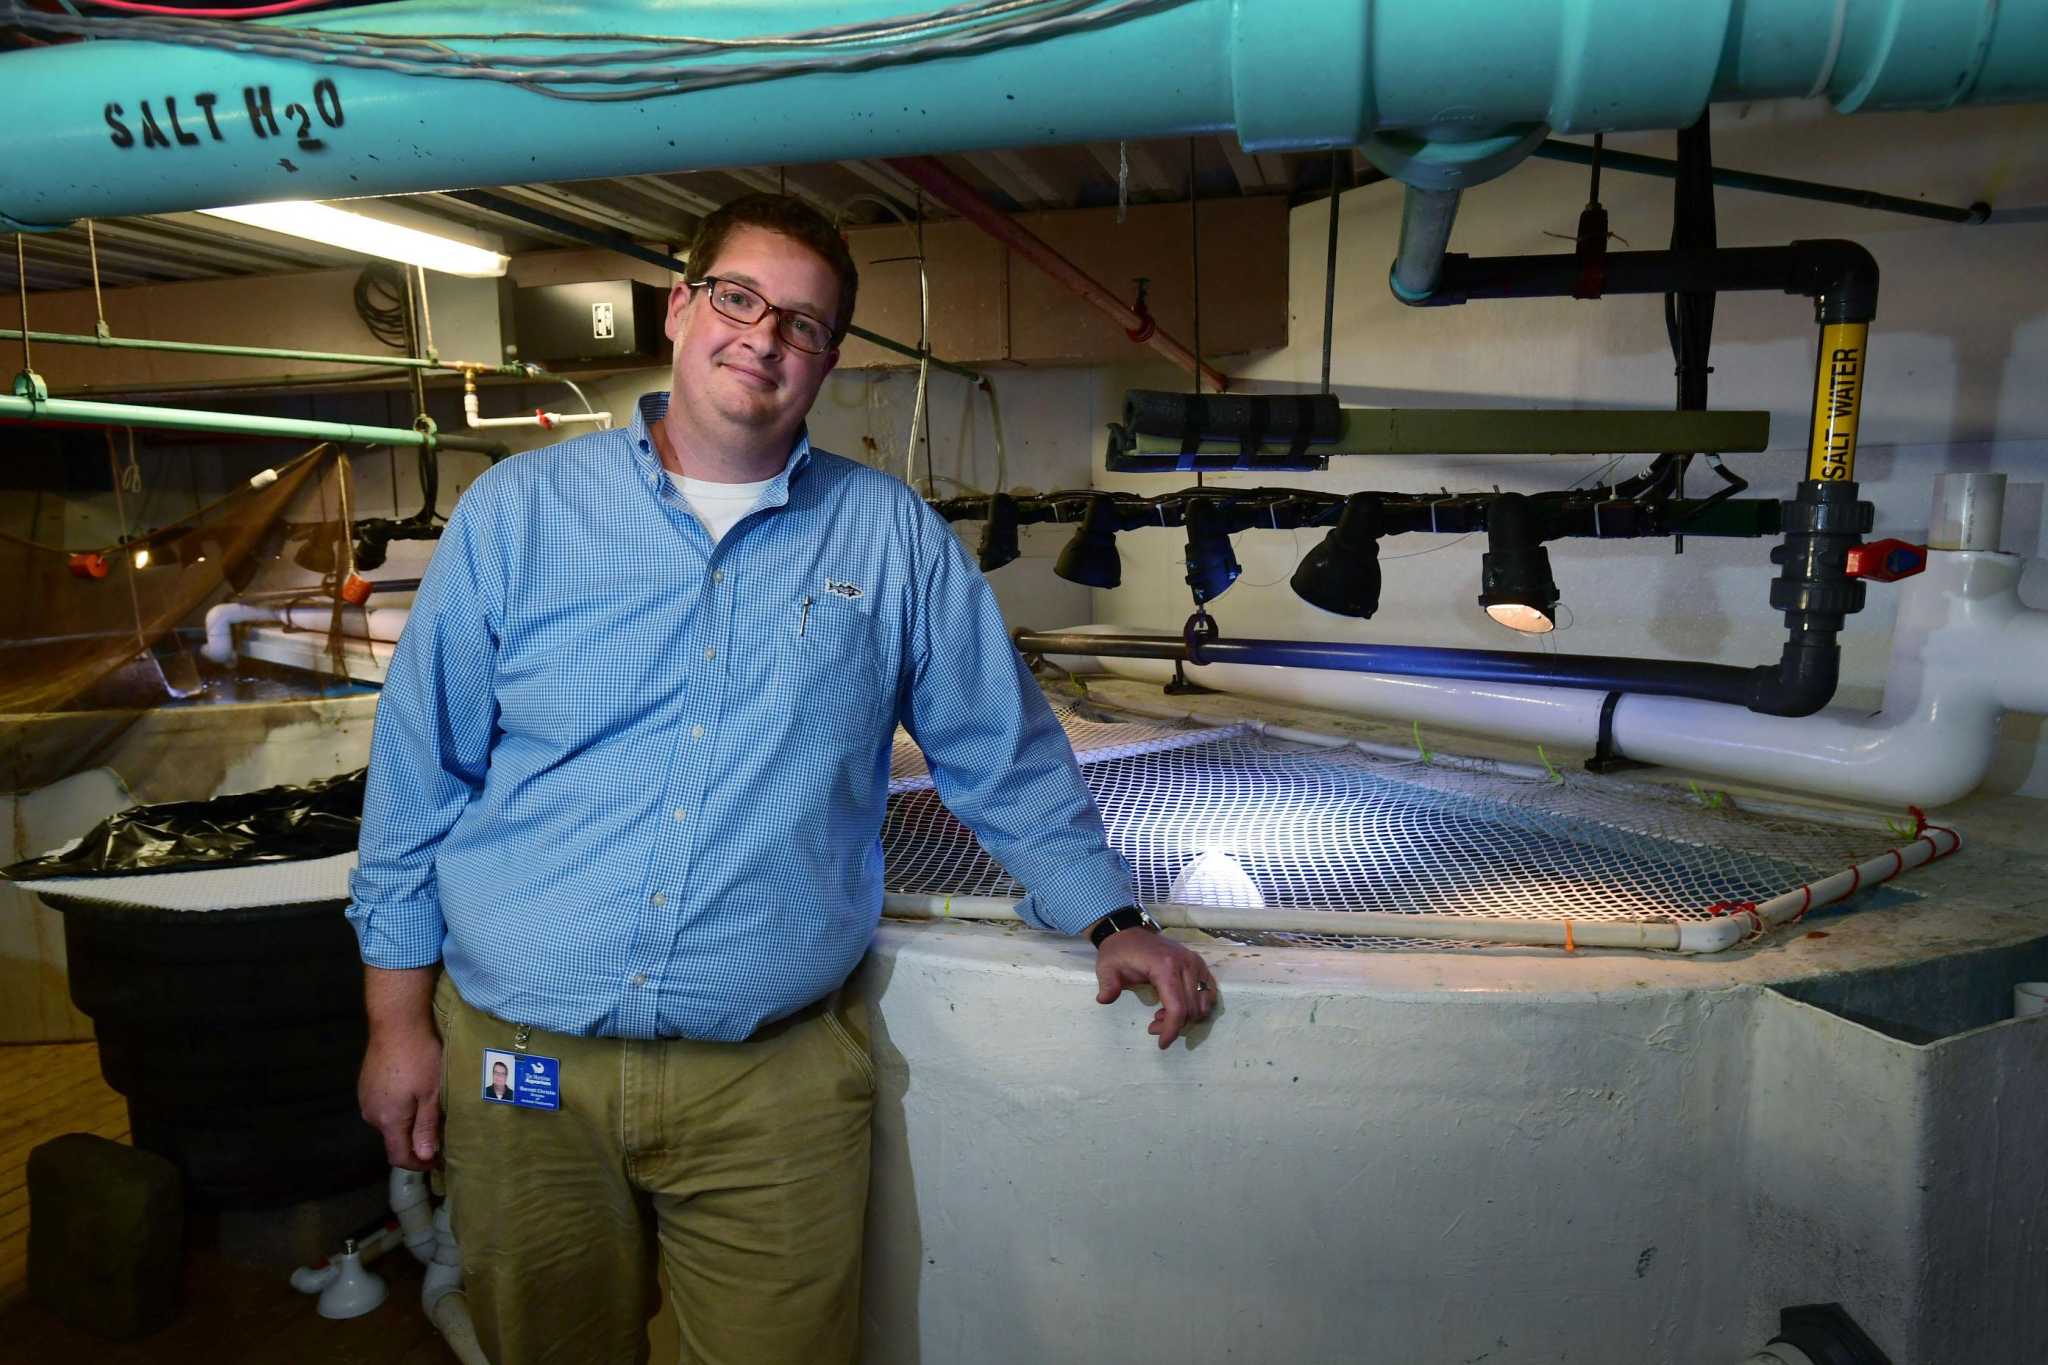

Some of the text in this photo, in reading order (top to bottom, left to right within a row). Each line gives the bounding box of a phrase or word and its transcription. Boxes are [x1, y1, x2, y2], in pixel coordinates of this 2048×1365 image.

[104, 78, 345, 151] SALT H2O
[1822, 348, 1859, 481] SALT WATER
